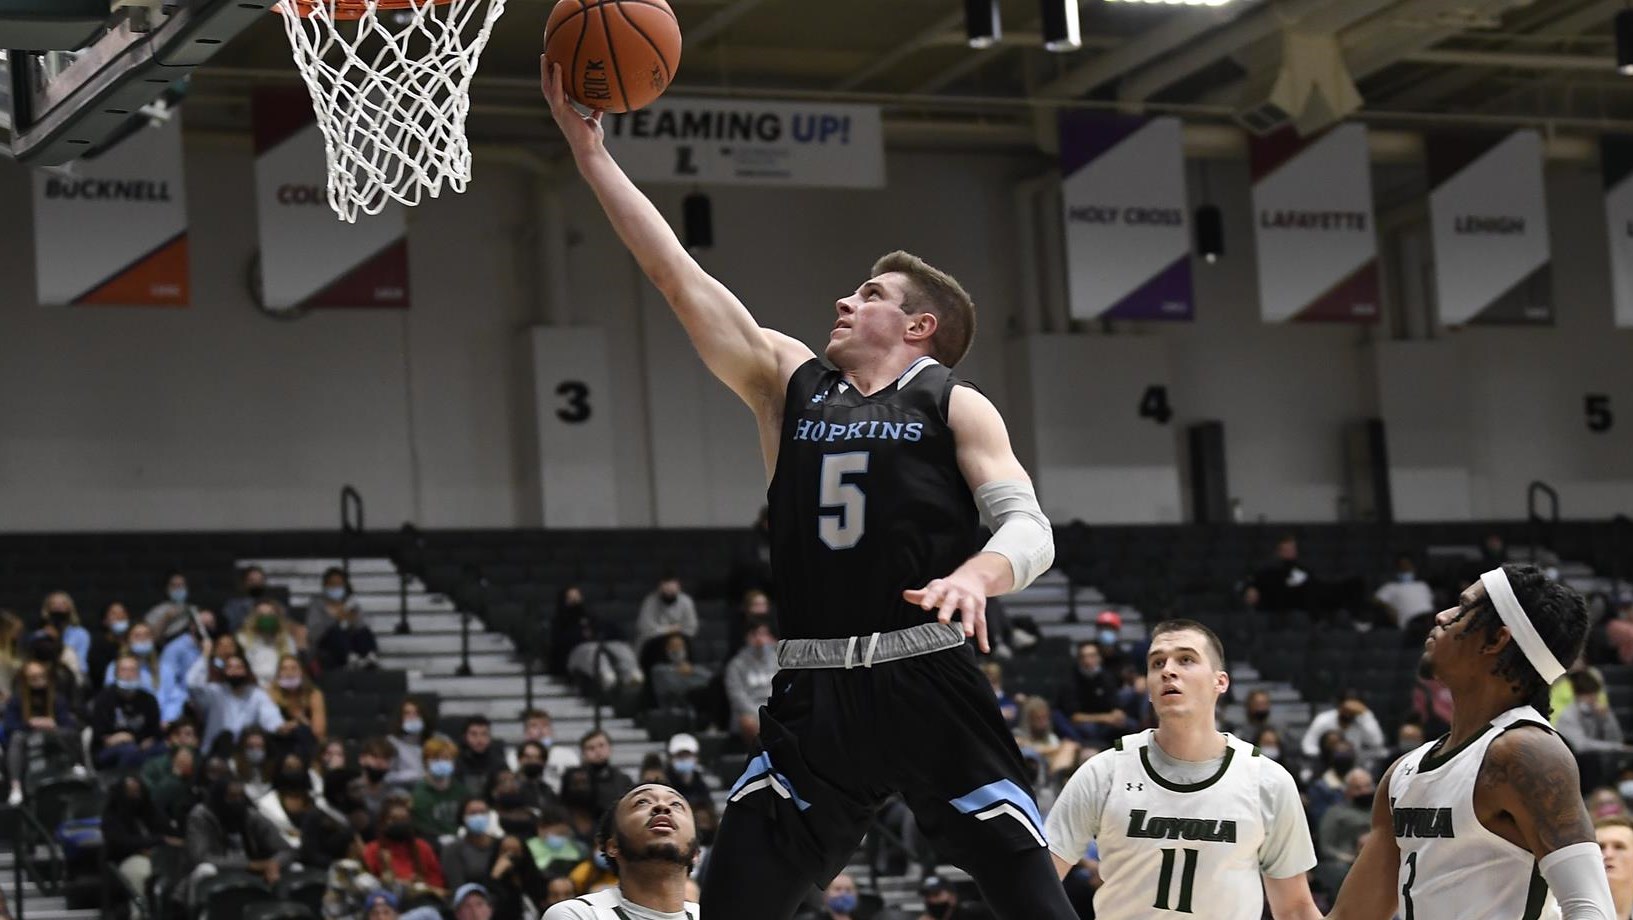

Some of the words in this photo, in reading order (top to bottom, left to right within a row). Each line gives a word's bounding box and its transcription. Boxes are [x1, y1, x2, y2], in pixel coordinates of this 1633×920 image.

[583, 60, 612, 100] ROCK
[608, 109, 781, 142] TEAMING
[792, 113, 851, 145] UP!
[45, 178, 171, 201] BUCKNELL
[1069, 206, 1118, 225] HOLY
[1123, 207, 1183, 227] CROSS
[1260, 209, 1368, 232] LAFAYETTE
[1454, 215, 1526, 236] LEHIGH
[555, 381, 592, 424] 3
[1138, 384, 1173, 424] 4
[1584, 394, 1614, 434] 5
[793, 418, 924, 442] HOPKINS
[818, 451, 870, 551] 5
[1390, 797, 1455, 839] OYOLA
[1152, 848, 1199, 914] 11
